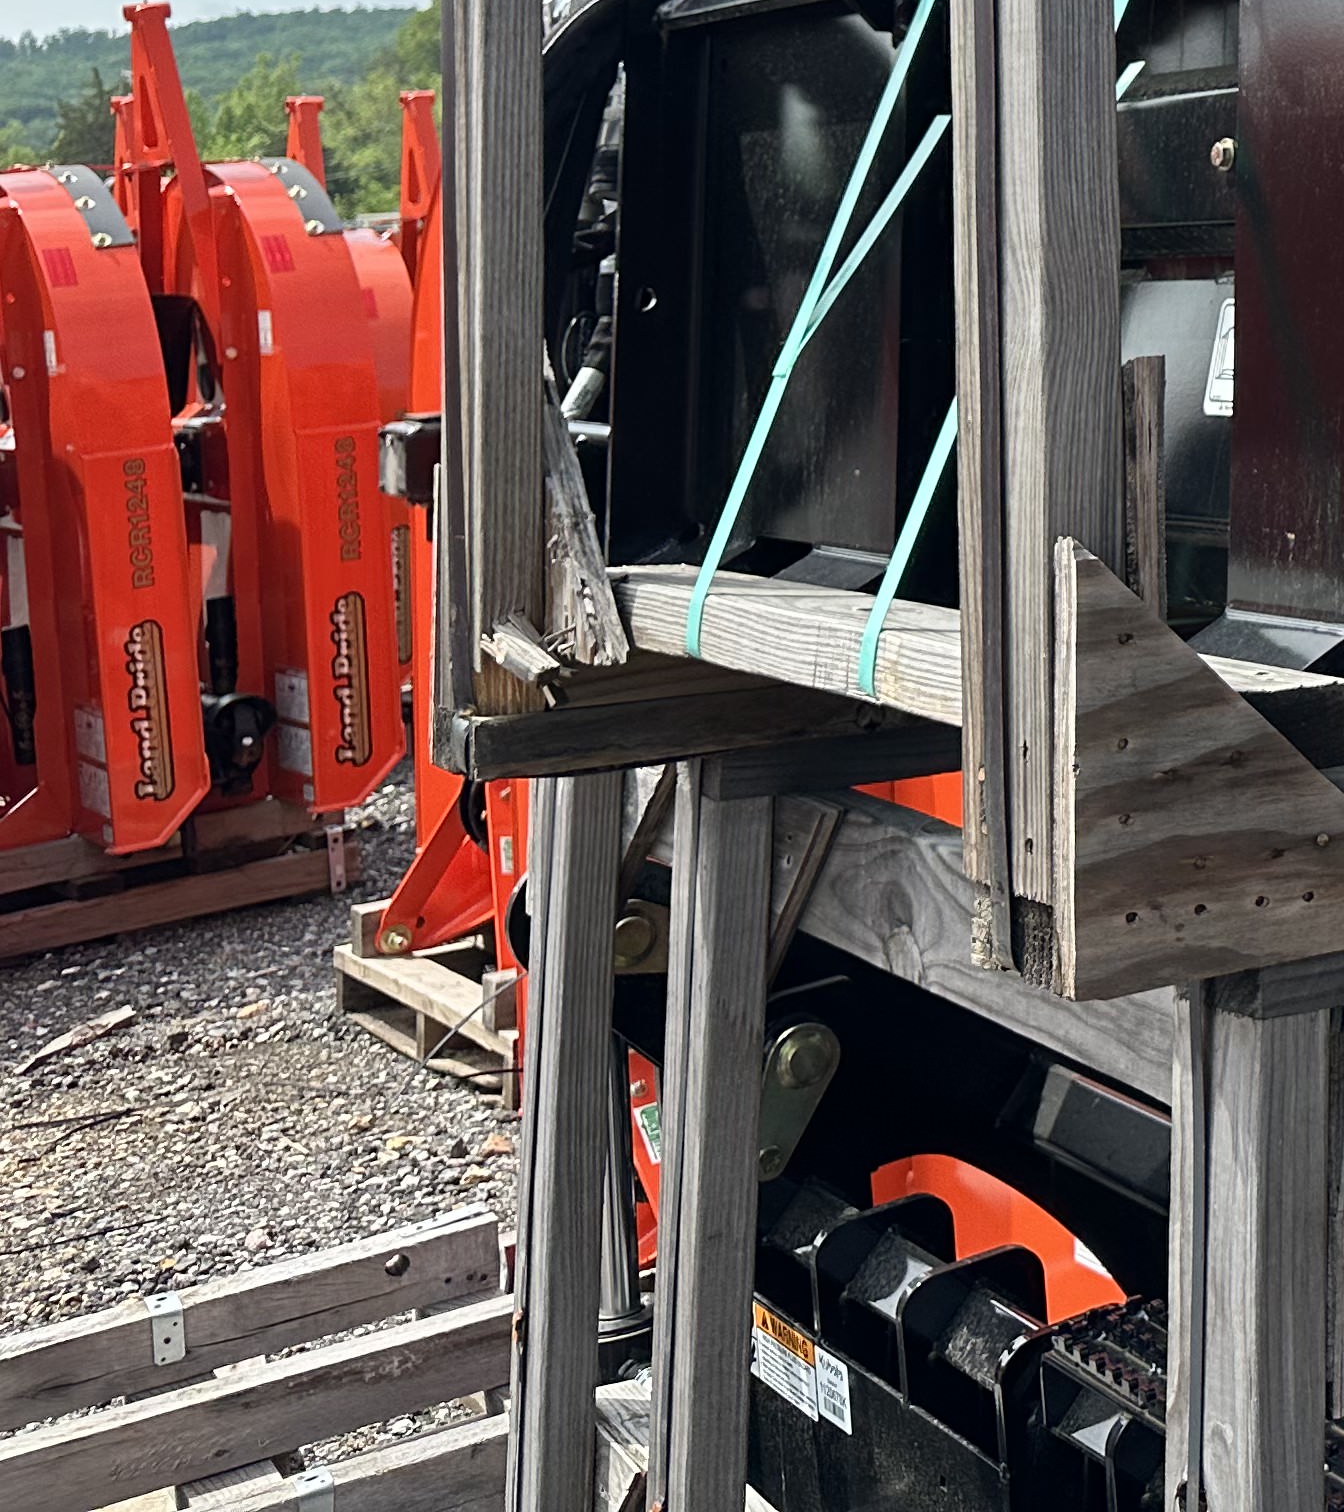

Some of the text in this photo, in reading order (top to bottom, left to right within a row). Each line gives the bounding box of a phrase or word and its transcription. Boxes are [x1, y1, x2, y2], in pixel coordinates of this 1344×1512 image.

[124, 458, 154, 588] RCR1248
[335, 435, 361, 561] RCR1248
[126, 624, 156, 801] Land Pride
[770, 1316, 808, 1358] WARNING
